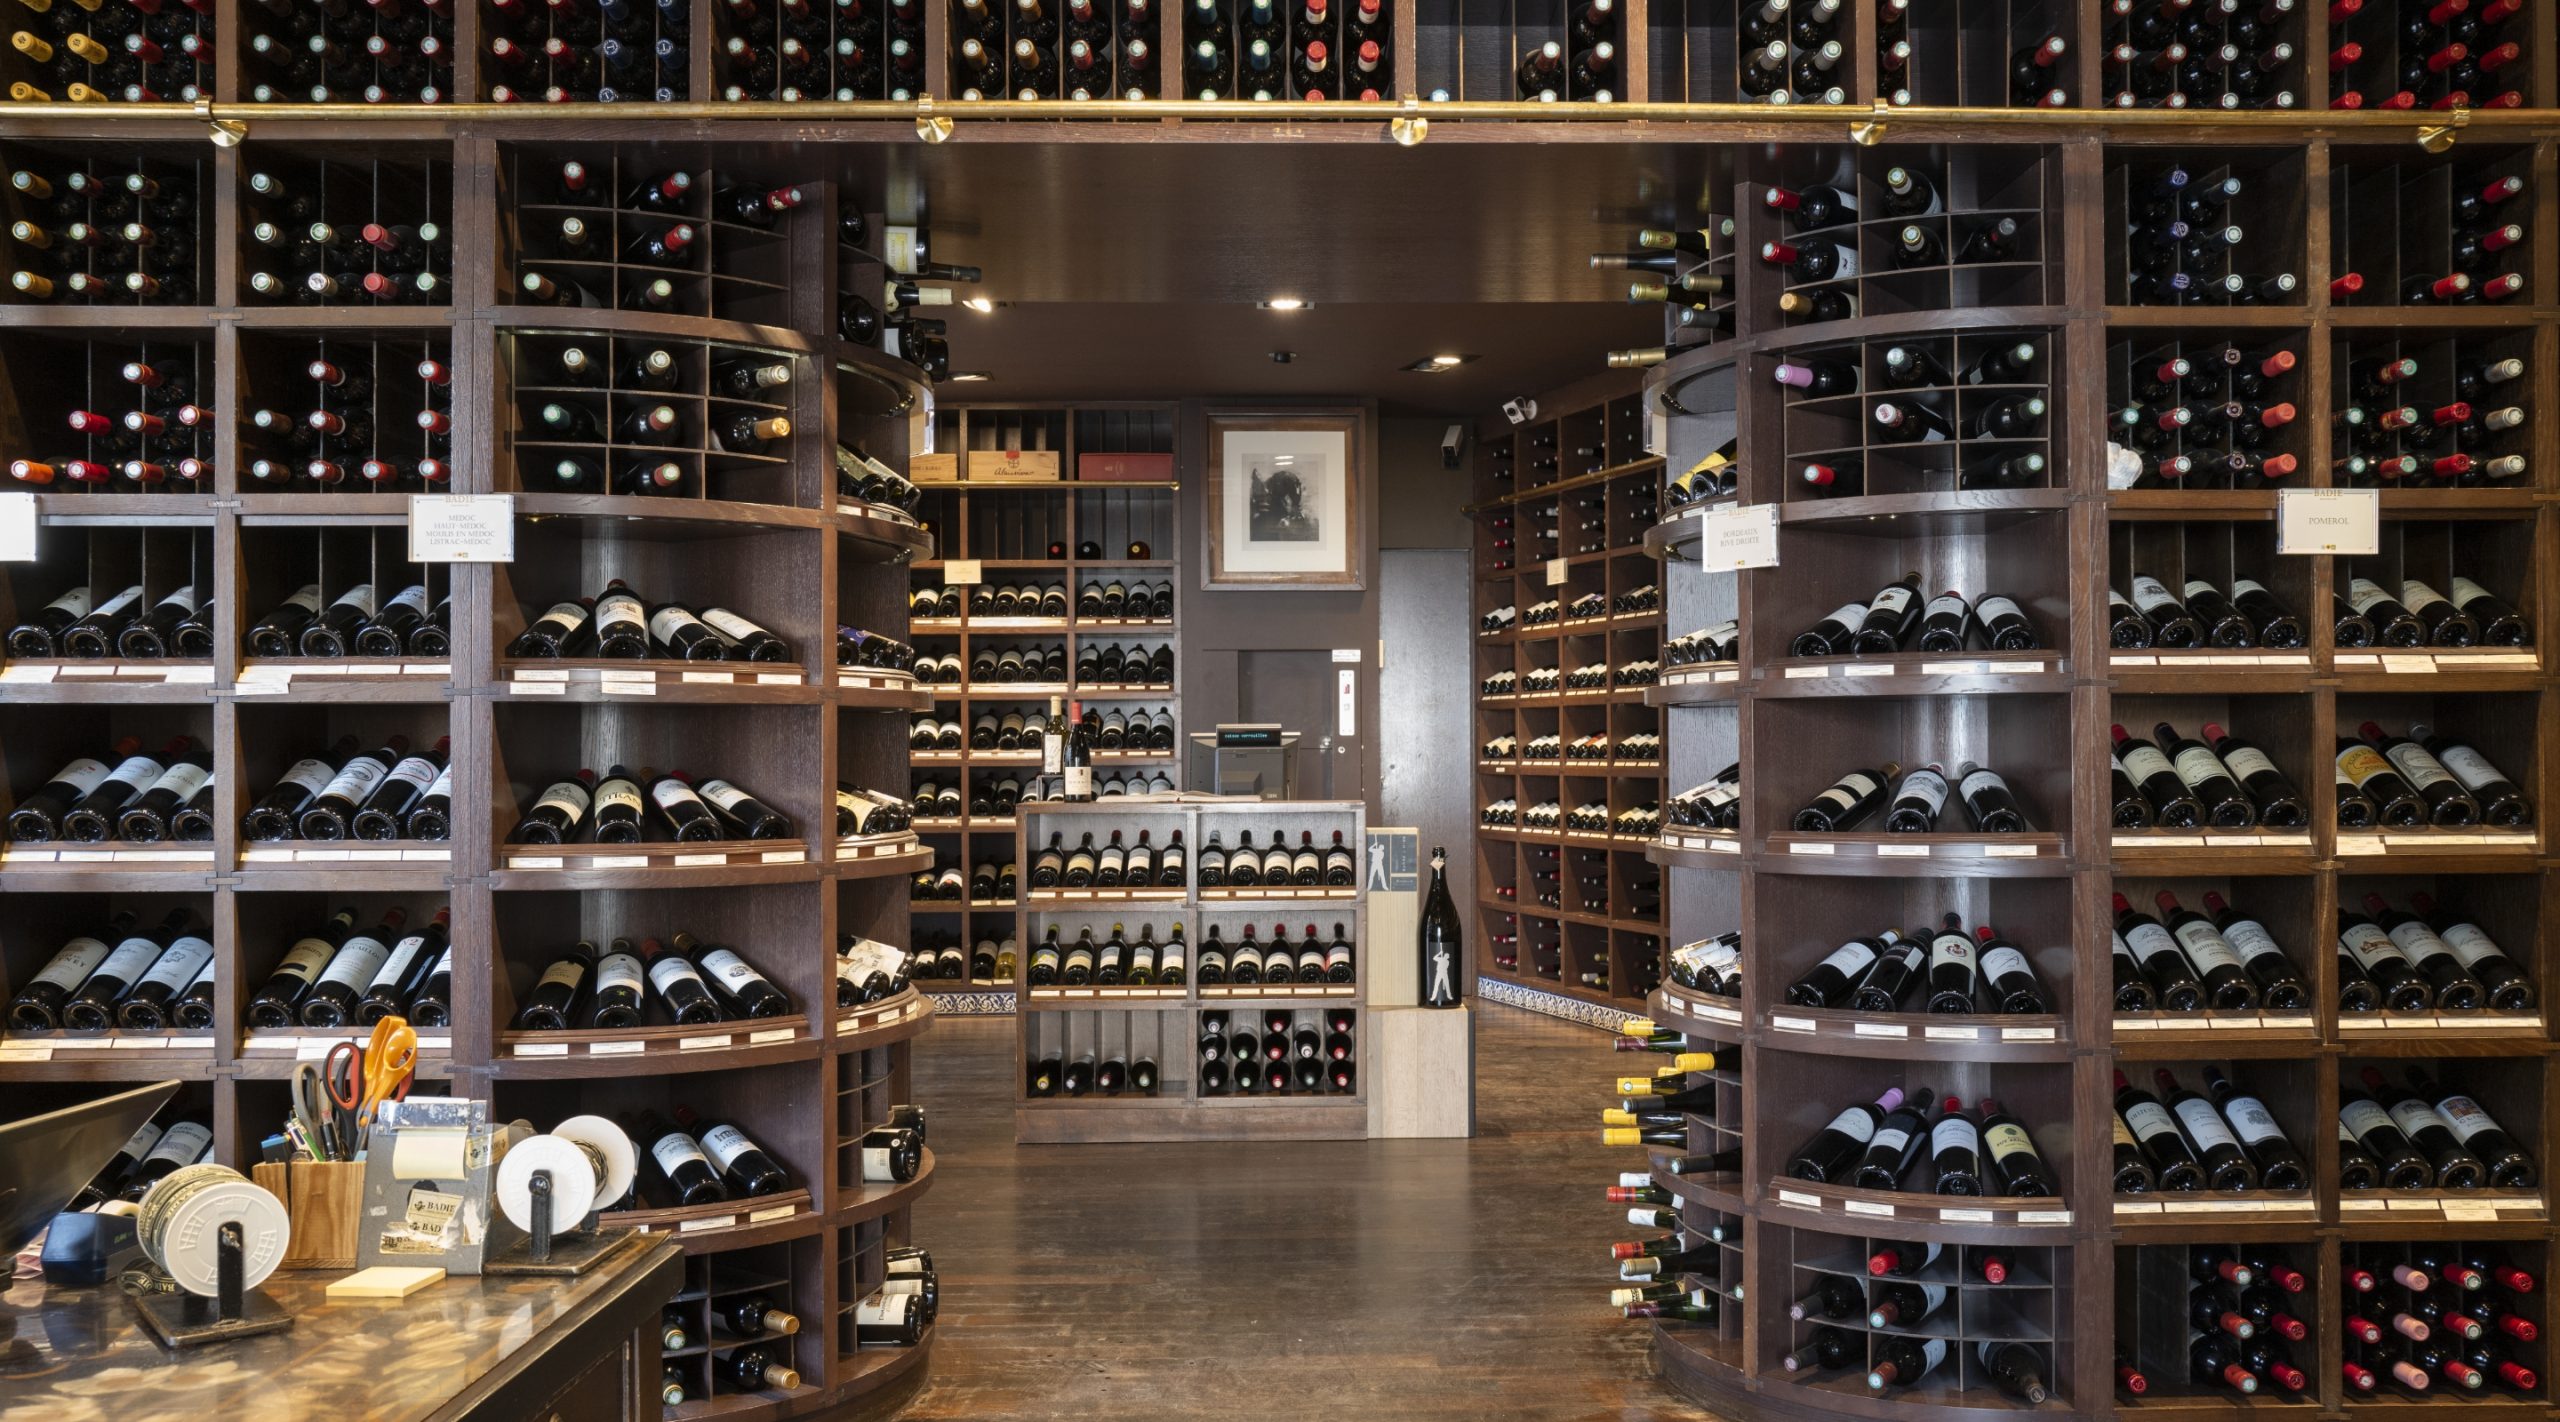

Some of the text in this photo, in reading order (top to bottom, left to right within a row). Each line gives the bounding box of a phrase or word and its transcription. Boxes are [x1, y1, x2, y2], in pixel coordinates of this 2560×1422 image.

[2314, 489, 2343, 497] BADIE
[2308, 517, 2349, 525] POMEROL
[427, 1202, 456, 1213] BADIE
